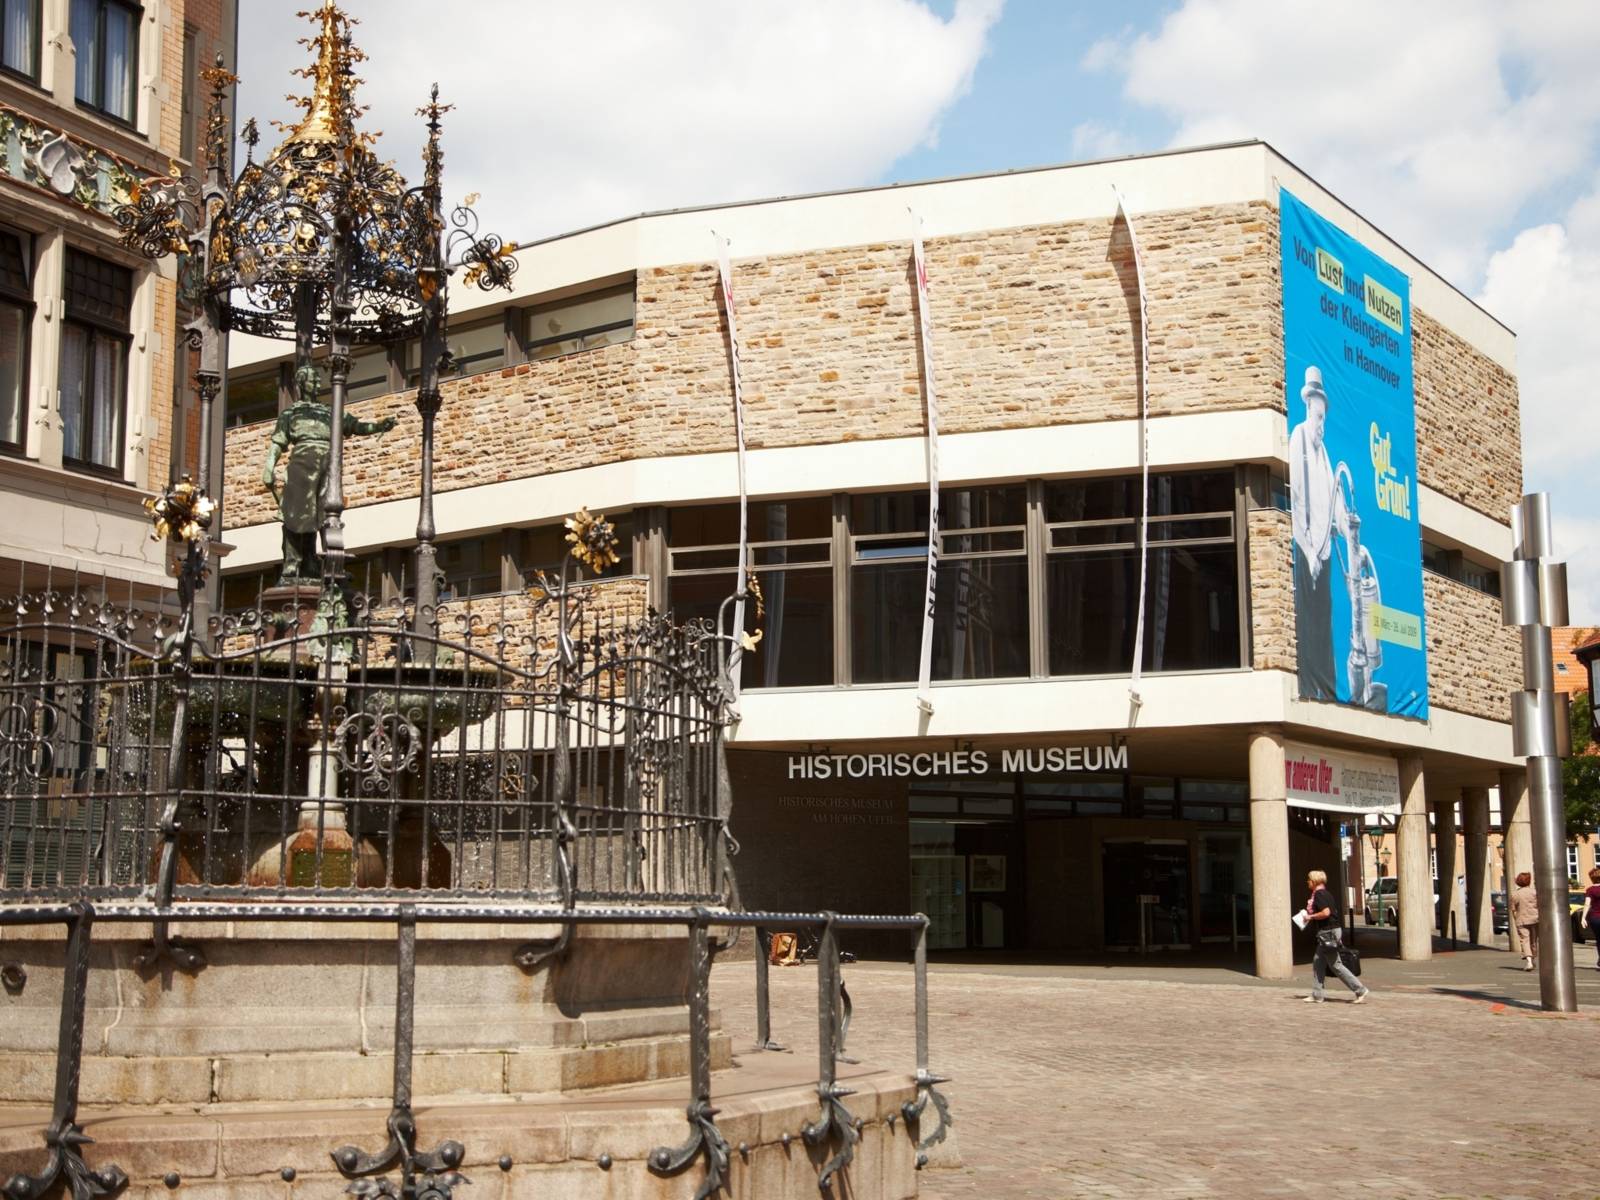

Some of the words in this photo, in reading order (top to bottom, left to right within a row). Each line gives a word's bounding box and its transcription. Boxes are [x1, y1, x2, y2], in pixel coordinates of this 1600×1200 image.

[1293, 236, 1316, 272] Von
[1318, 252, 1343, 289] Lust
[1345, 276, 1365, 303] und
[1367, 285, 1402, 327] Nutzen
[1320, 293, 1339, 321] der
[1341, 302, 1400, 358] Kleingärten
[1343, 339, 1353, 364] in
[1355, 345, 1400, 390] Hannover
[788, 751, 989, 779] HISTORISCHES
[1002, 746, 1128, 773] MUSEUM
